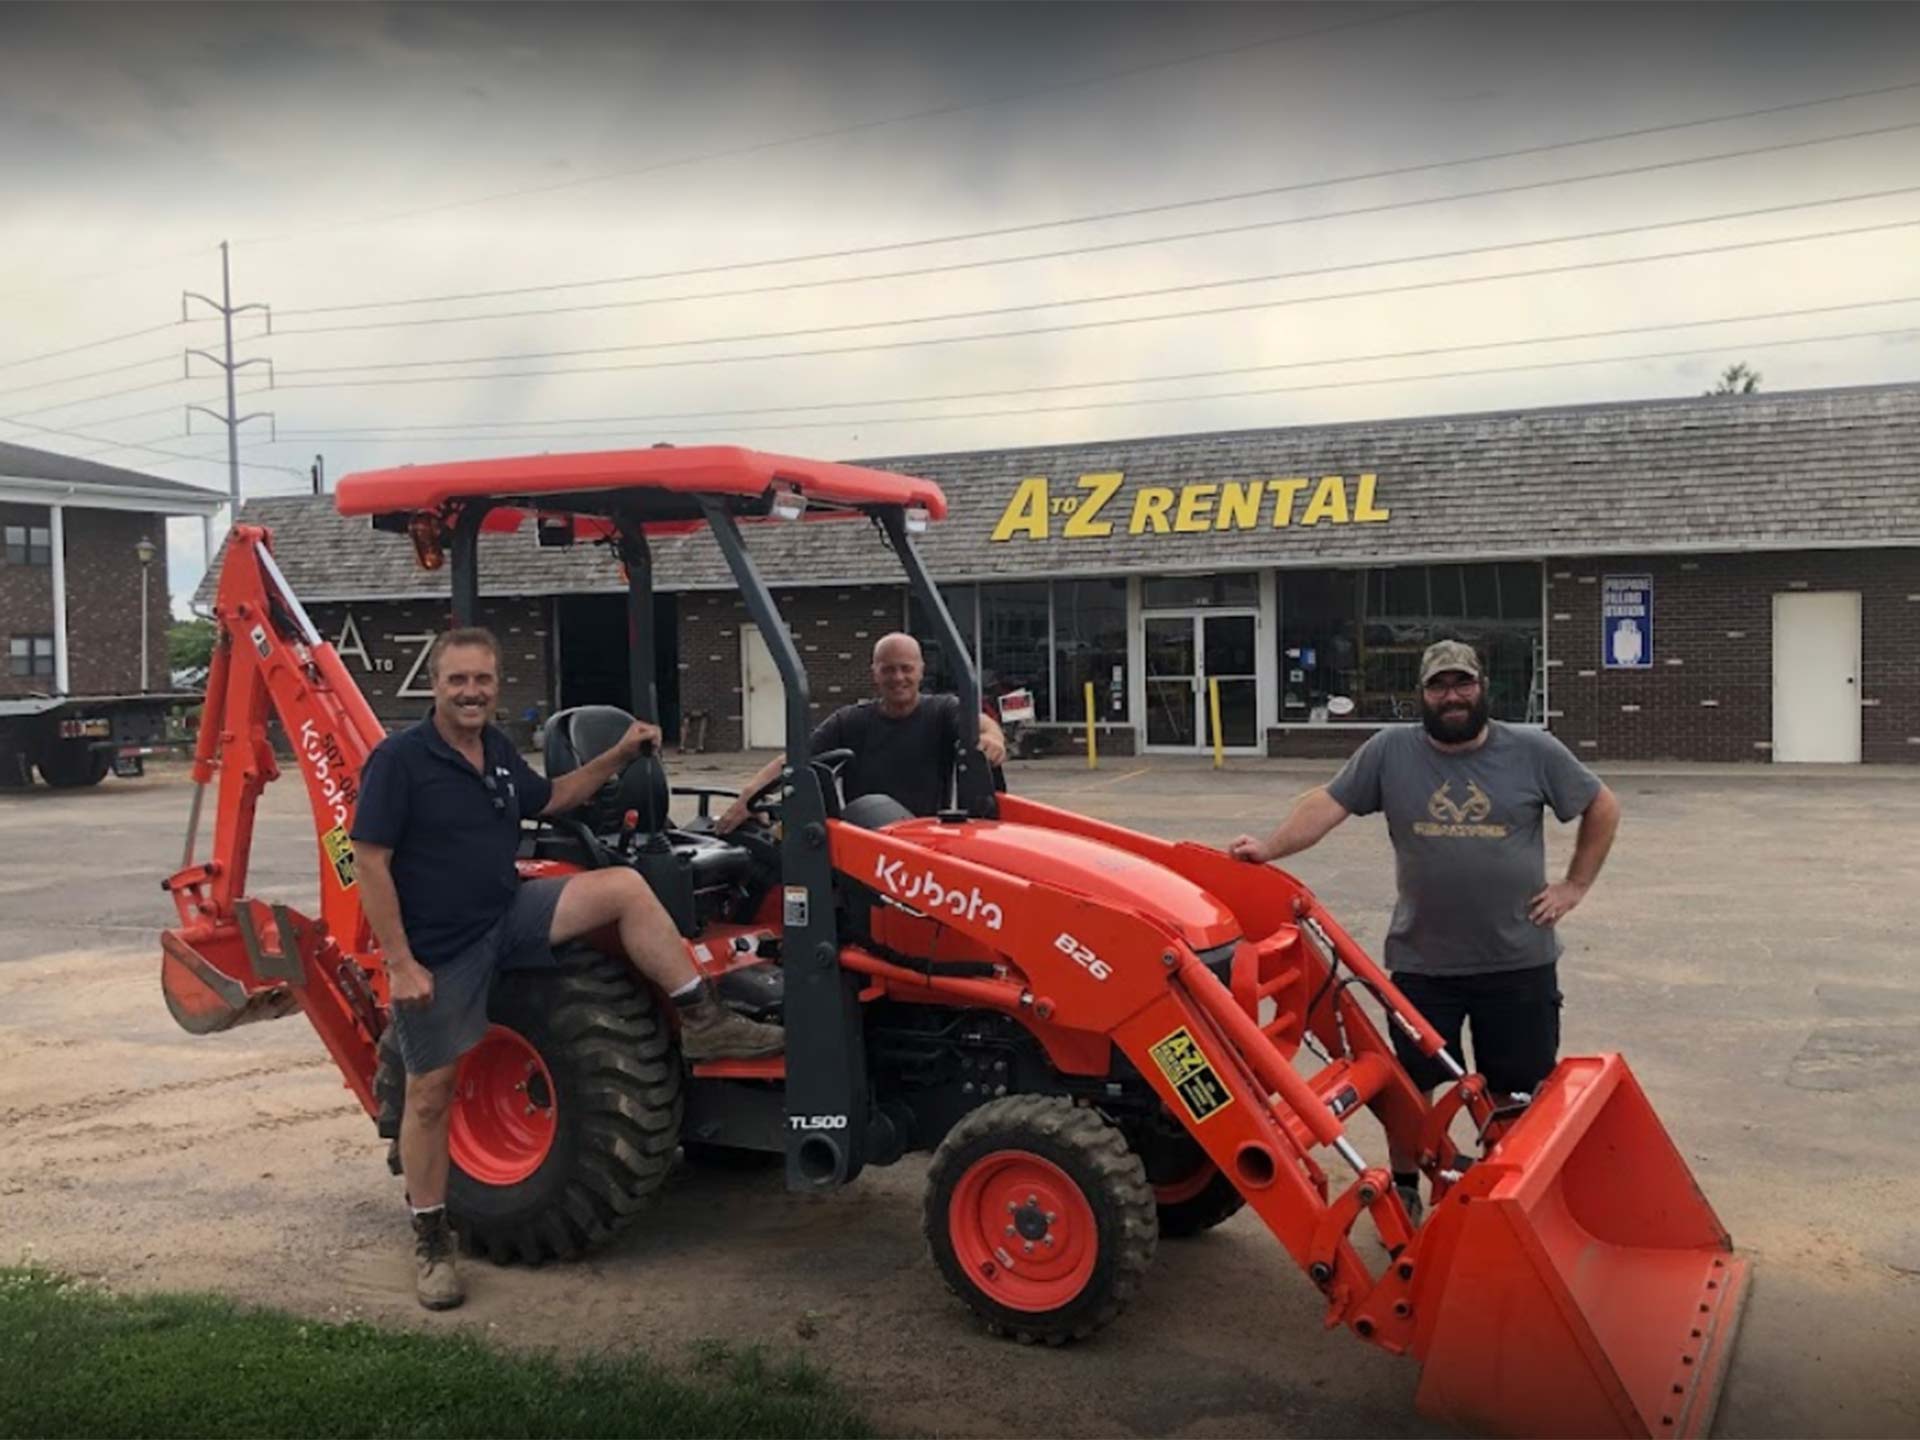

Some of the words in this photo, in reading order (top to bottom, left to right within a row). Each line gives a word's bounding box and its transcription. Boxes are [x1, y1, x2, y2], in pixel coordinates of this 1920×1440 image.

[990, 477, 1049, 541] A
[1051, 496, 1078, 514] TO
[1063, 472, 1124, 538] Z
[1128, 474, 1391, 534] RENTAL
[337, 611, 373, 671] A
[374, 659, 394, 671] TO
[394, 634, 438, 697] Z
[301, 719, 347, 826] Kubota
[875, 854, 1002, 930] Kubota
[1054, 932, 1113, 981] B26
[789, 1114, 848, 1130] TL500
